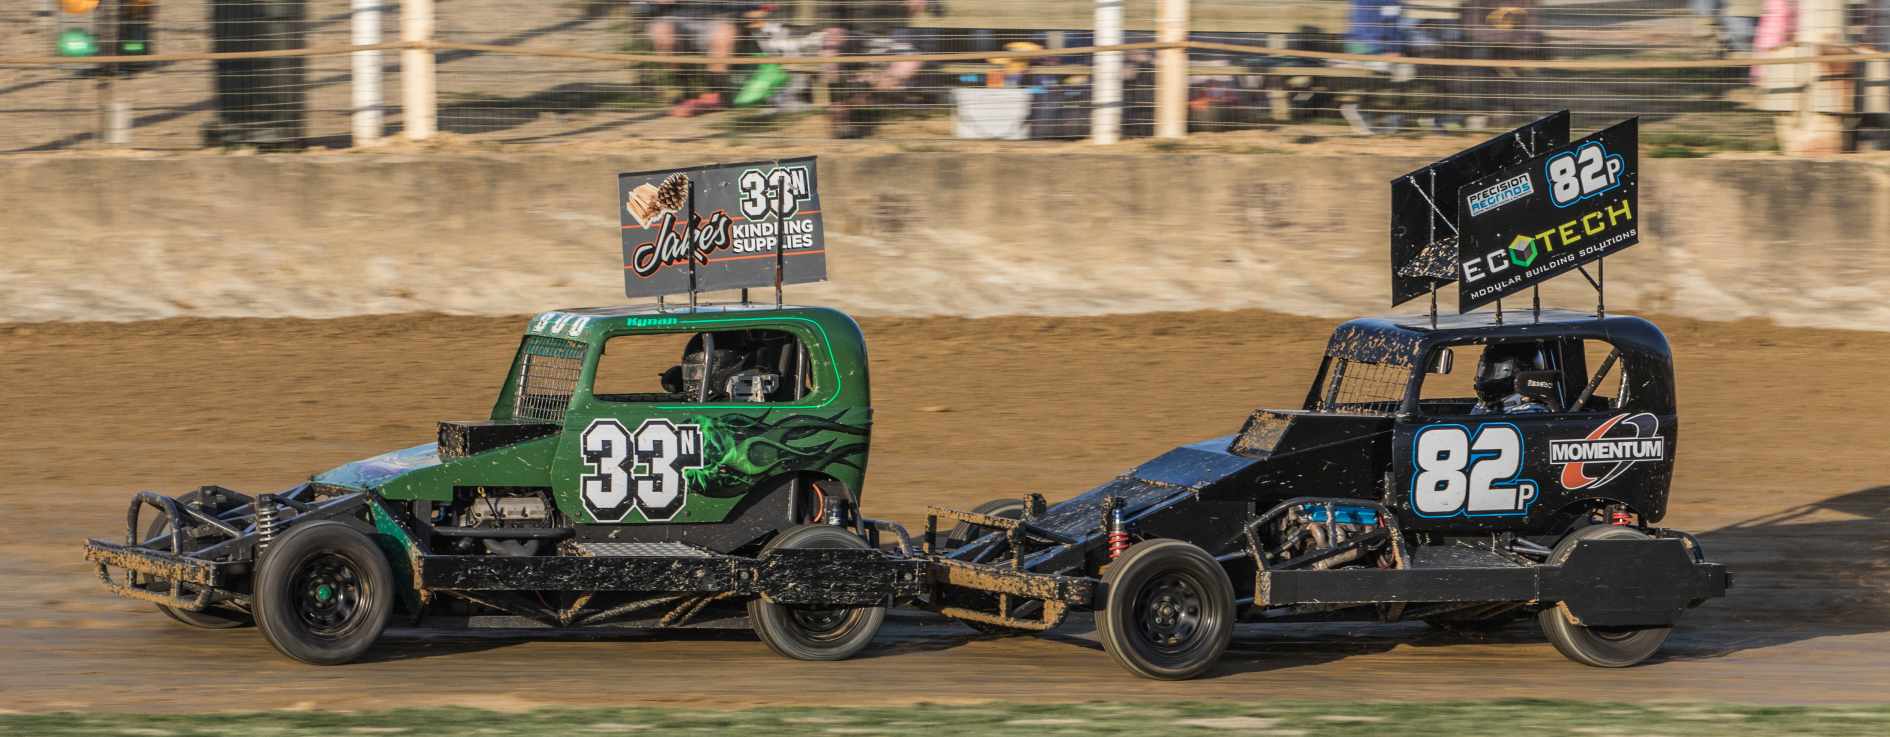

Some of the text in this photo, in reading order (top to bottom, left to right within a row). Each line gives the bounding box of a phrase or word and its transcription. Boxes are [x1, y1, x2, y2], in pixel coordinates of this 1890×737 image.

[739, 167, 809, 220] 33N
[1547, 143, 1622, 205] 82P
[1470, 228, 1638, 300] MODULAR BUILDING SOLUTIONS
[583, 419, 701, 519] 33N
[1412, 424, 1537, 516] 82P
[1551, 440, 1663, 461] MOMENTUM
